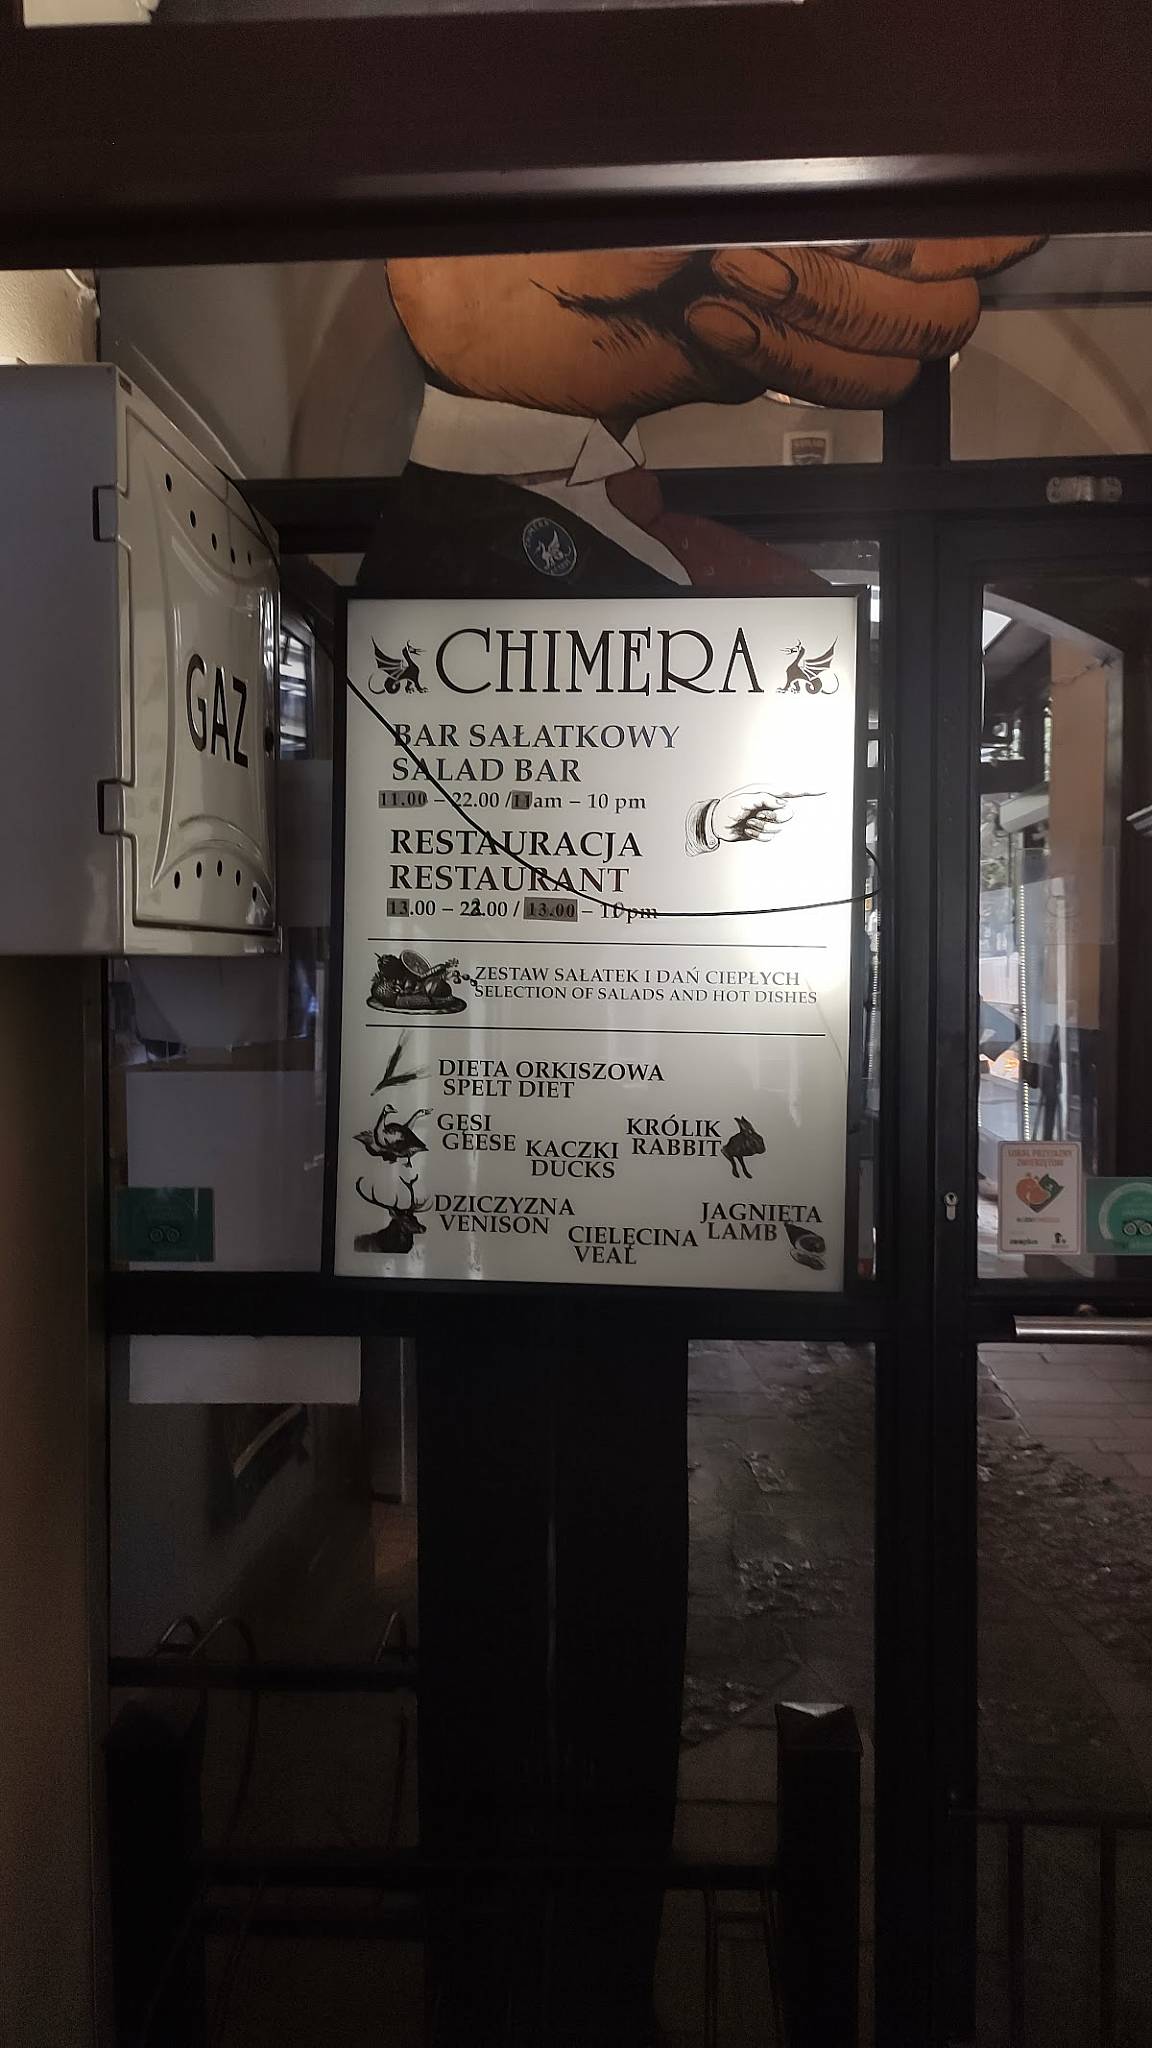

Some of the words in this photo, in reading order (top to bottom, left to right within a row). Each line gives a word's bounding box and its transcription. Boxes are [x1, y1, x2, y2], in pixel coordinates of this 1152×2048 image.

[436, 627, 764, 696] CHIMERA
[186, 654, 248, 768] GAZ
[393, 724, 460, 748] BAR
[469, 724, 679, 748] SAŁATKOWY
[392, 757, 504, 781] SALAD
[515, 758, 581, 782] BAR
[380, 791, 428, 807] 11.00
[453, 792, 499, 808] 22.00
[587, 793, 609, 808] 10
[615, 797, 646, 814] pm
[390, 829, 643, 863] RESTAURACJA
[389, 865, 630, 892] RESTAURANT
[389, 899, 436, 916] 13.00
[528, 901, 576, 918] 13.00
[475, 966, 549, 981] ZESTAW
[554, 968, 638, 983] SAŁATEK
[645, 970, 651, 983] I
[656, 967, 700, 985] DAŃ
[706, 971, 799, 986] CIEPŁYCH
[474, 985, 567, 999] SELECTION
[572, 987, 594, 1000] OF
[598, 987, 664, 1001] SALADS
[669, 989, 708, 1002] AND
[713, 990, 751, 1003] HOT
[755, 990, 817, 1004] DISHES
[439, 1059, 509, 1078] DIETA
[516, 1061, 665, 1081] ORKISZOWA
[443, 1079, 512, 1097] SPELT
[518, 1081, 575, 1098] DIET
[437, 1114, 492, 1134] GĘSI
[626, 1114, 722, 1137] KRÓLIK
[442, 1133, 516, 1151] GEESE
[525, 1140, 619, 1159] KACZKI
[631, 1138, 722, 1157] RABBIT
[531, 1160, 615, 1178] DUCKS
[434, 1195, 575, 1215] DZICZYZNA
[440, 1215, 549, 1234] VENISON
[707, 1222, 777, 1241] LAMB
[568, 1226, 698, 1249] CIELĘCINA
[574, 1246, 637, 1264] VEAL
